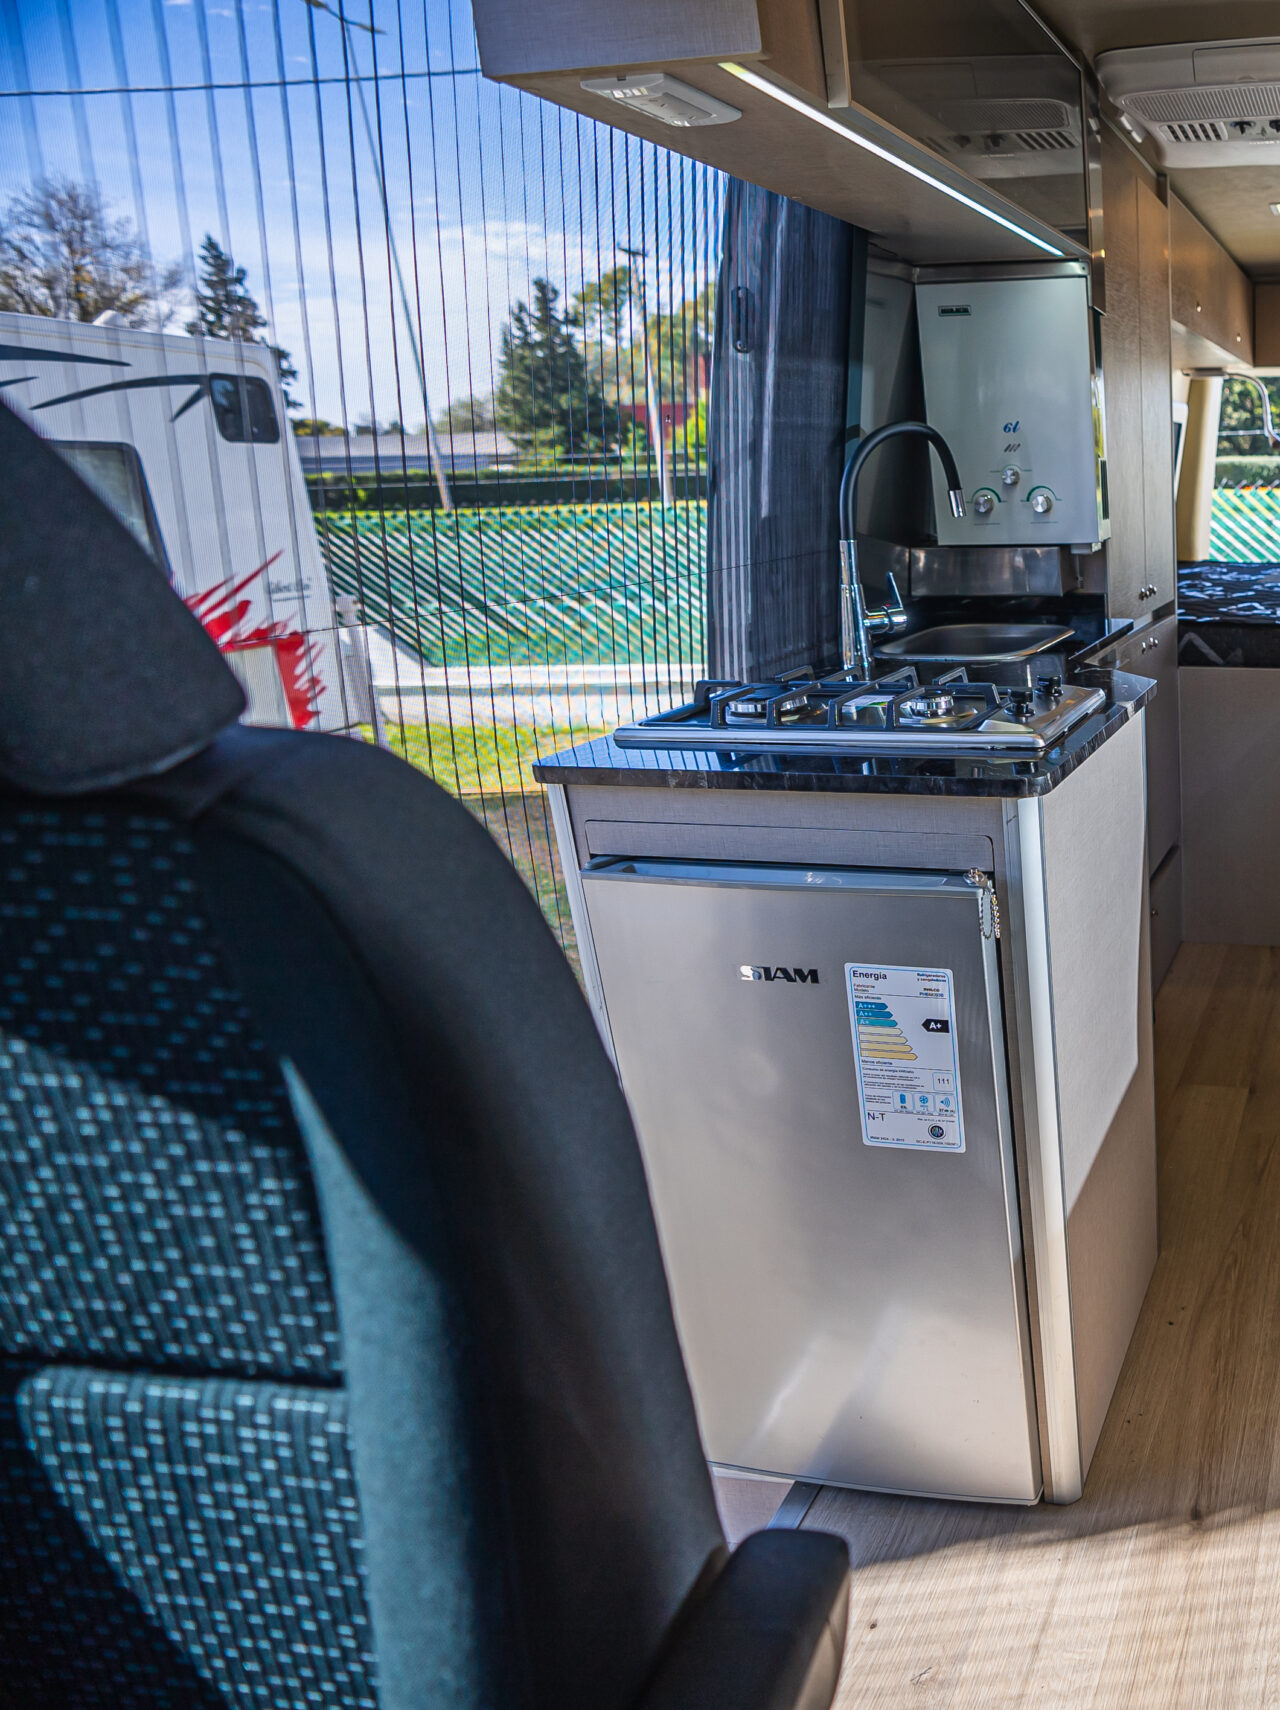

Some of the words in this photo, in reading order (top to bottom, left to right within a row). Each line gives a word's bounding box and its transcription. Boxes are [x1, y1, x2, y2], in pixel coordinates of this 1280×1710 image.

[740, 965, 820, 984] SIAM
[929, 1021, 942, 1030] A+
[937, 1077, 950, 1085] 111
[867, 1112, 886, 1122] N-T
